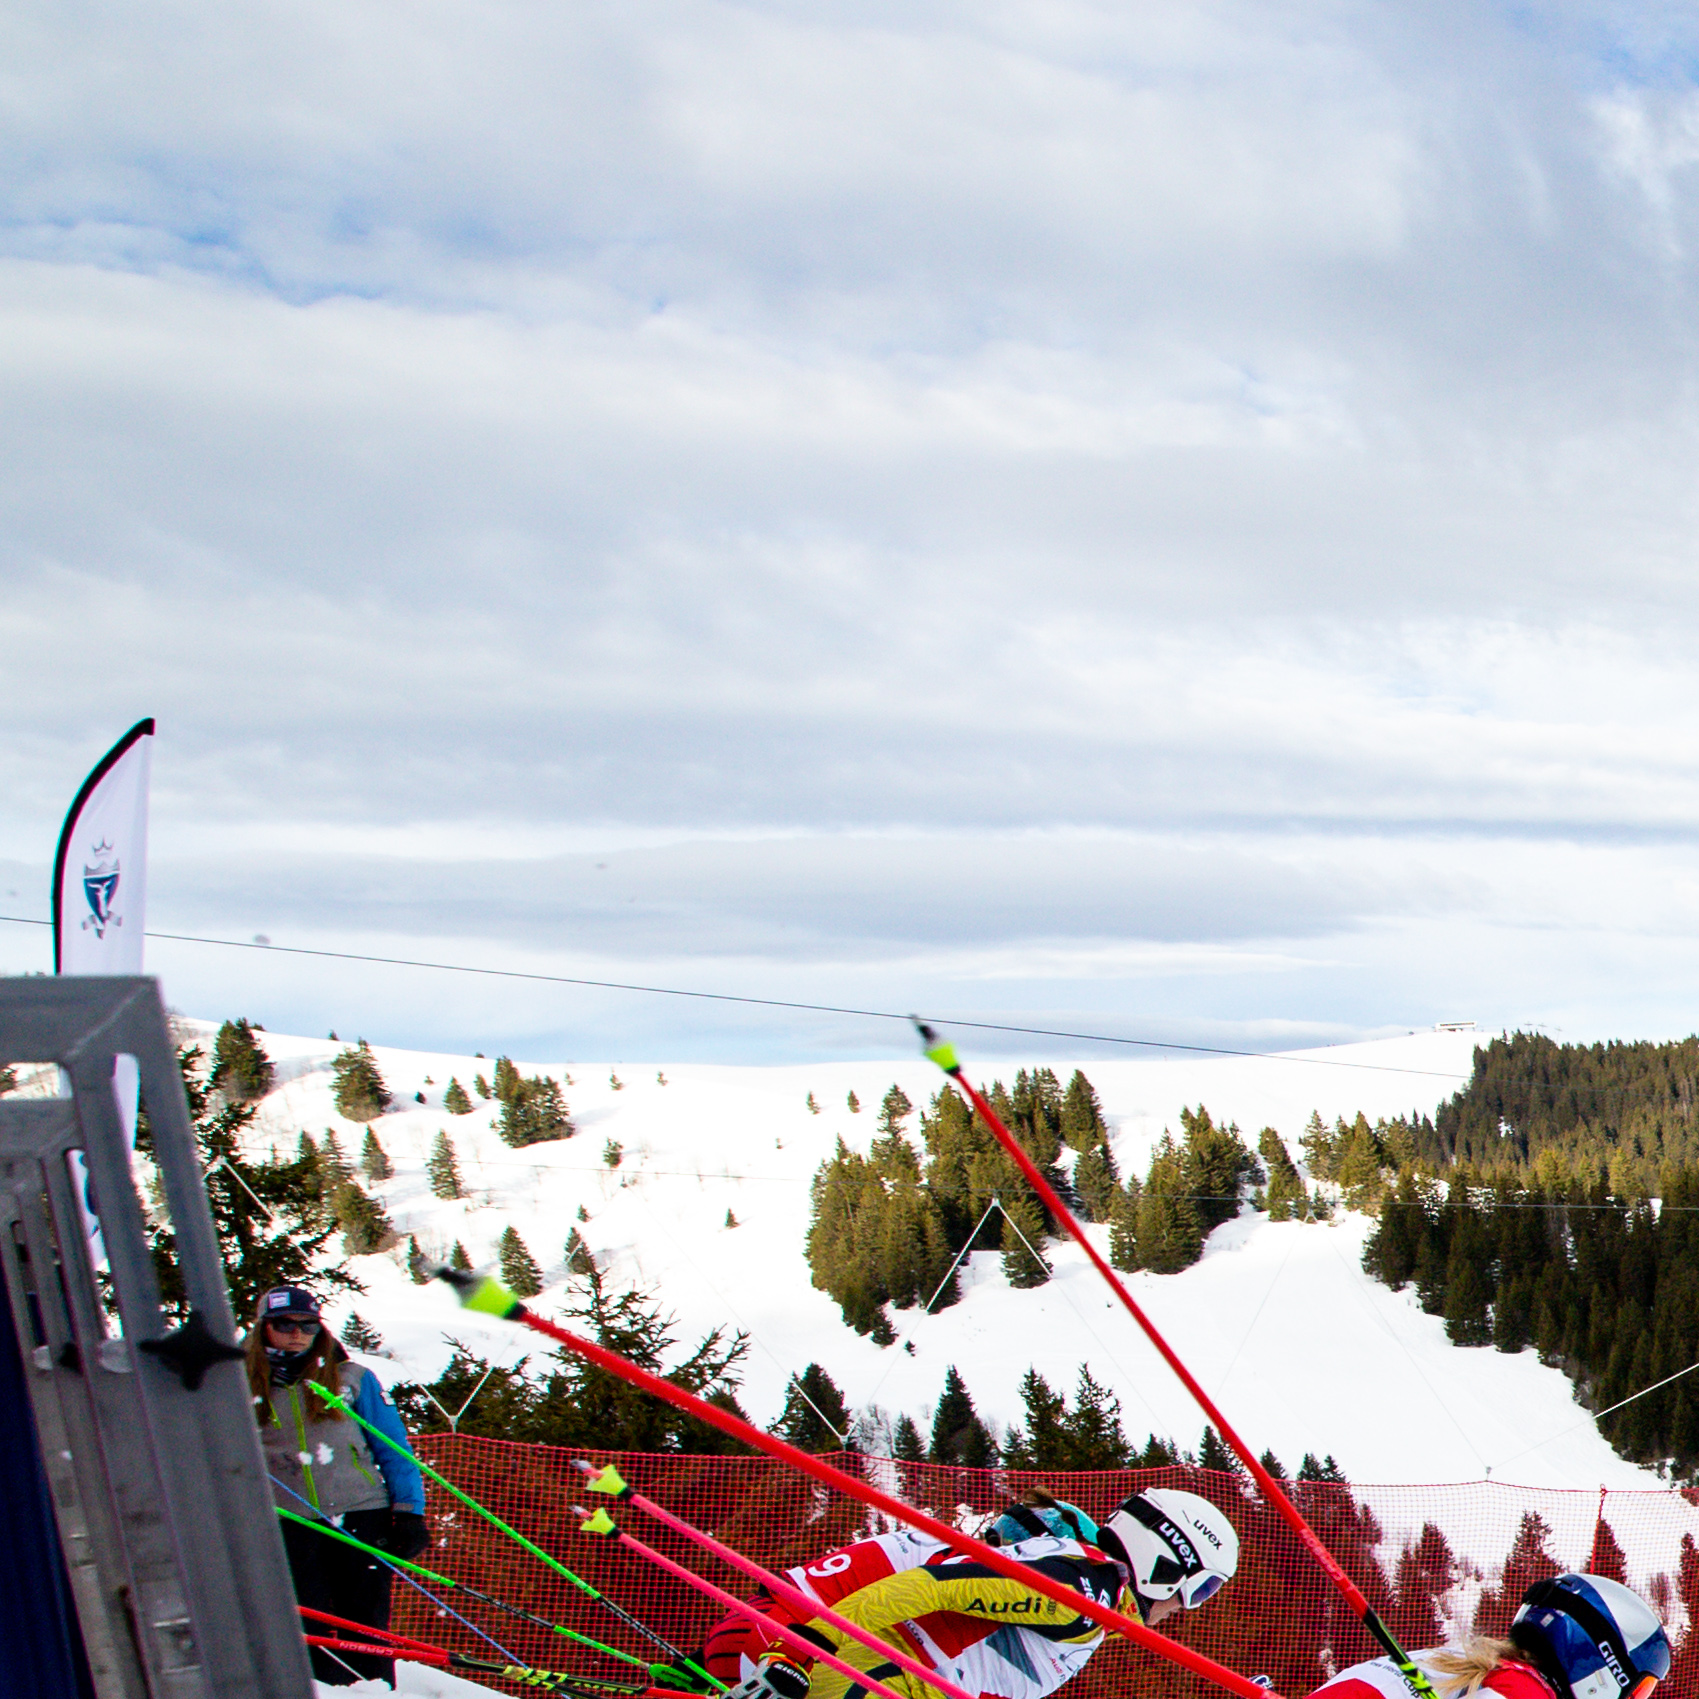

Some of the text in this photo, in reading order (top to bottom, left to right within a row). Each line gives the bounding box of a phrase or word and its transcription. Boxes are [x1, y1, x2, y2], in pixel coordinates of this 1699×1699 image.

[1160, 1521, 1198, 1570] uvex
[1193, 1518, 1223, 1550] uvex
[807, 1553, 852, 1578] 9
[964, 1597, 1042, 1615] Audi
[773, 1662, 811, 1687] ziener
[1598, 1641, 1631, 1688] GIRO
[1402, 1674, 1421, 1699] Cup
